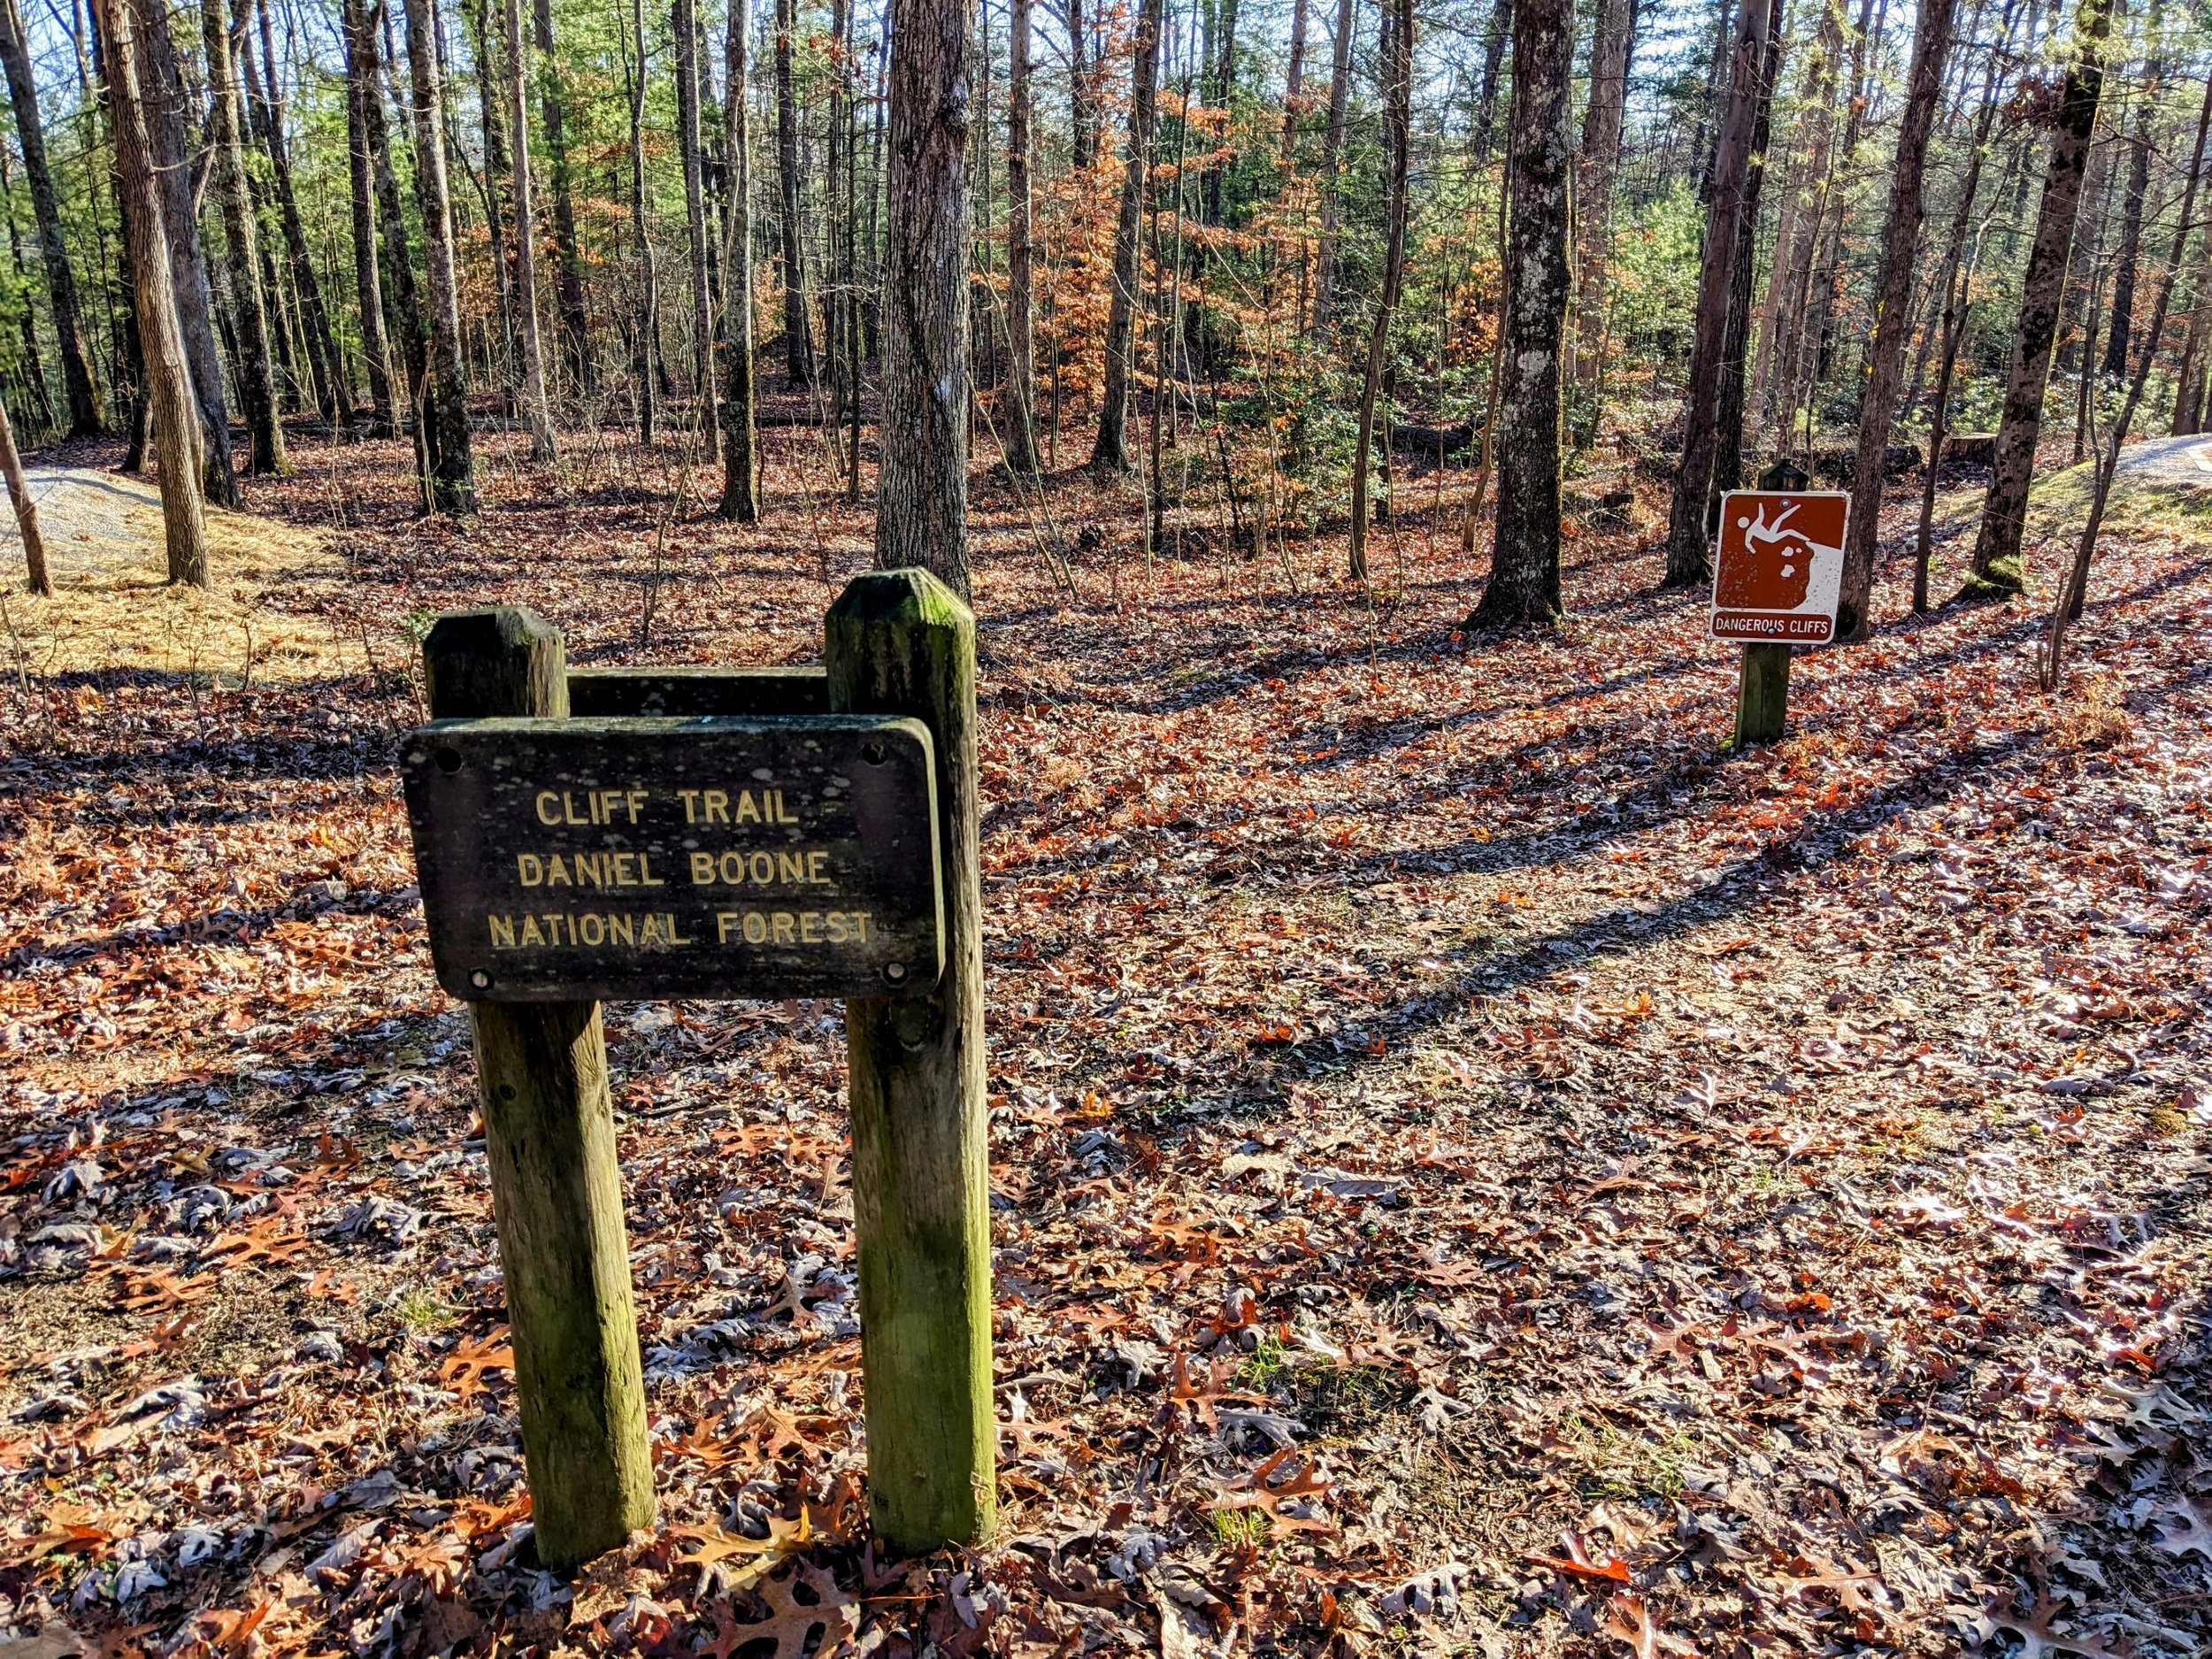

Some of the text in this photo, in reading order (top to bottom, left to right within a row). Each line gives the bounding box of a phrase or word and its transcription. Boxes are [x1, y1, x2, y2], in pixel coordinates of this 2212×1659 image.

[1716, 618, 1829, 634] DANGEROUS CLIFFS
[536, 789, 799, 825] CLIFF TRAIL
[518, 850, 831, 887] DANIEL BOONE
[488, 910, 872, 947] NATIONAL FOREST
